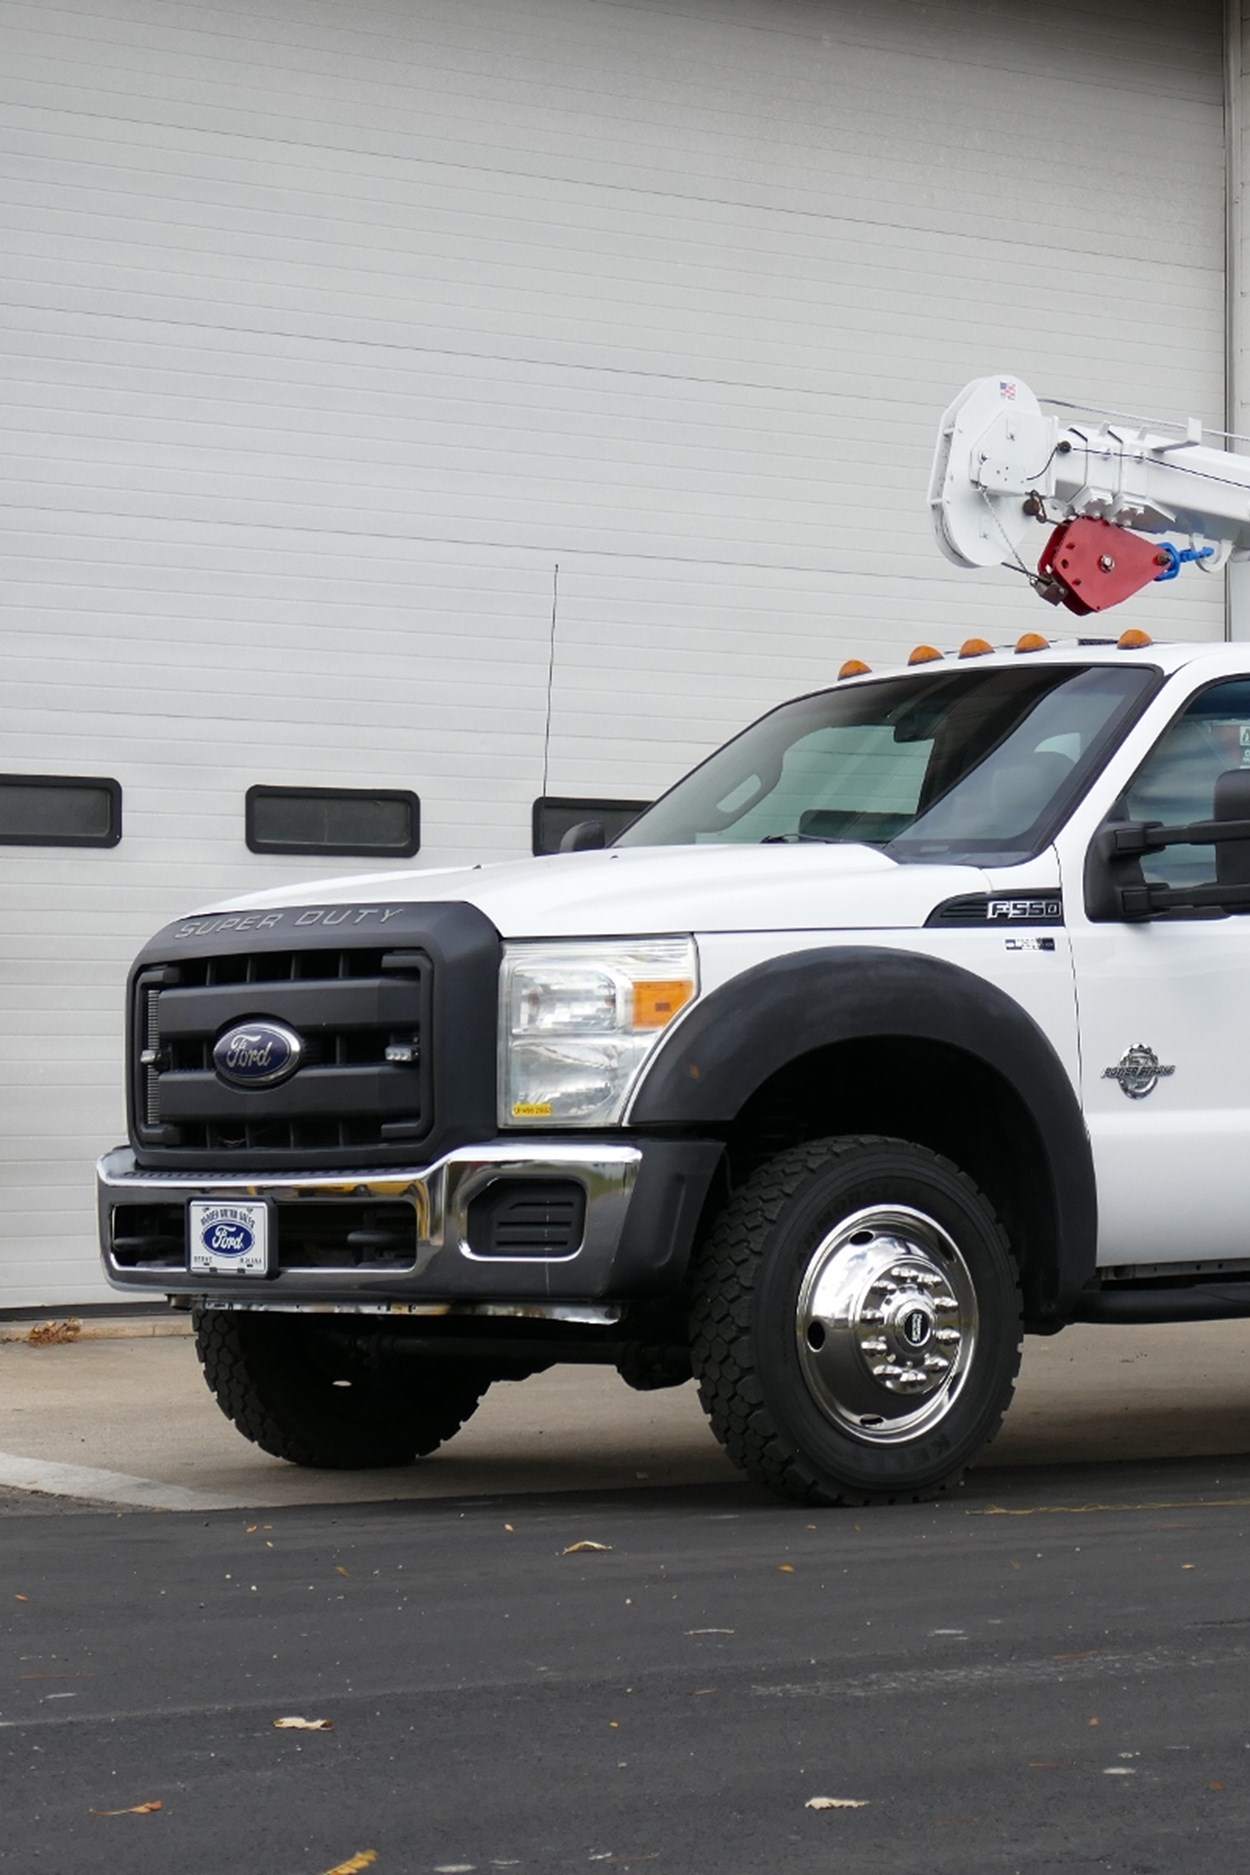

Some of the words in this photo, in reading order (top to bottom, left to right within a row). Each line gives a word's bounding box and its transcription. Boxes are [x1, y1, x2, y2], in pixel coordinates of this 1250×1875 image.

[174, 913, 284, 939] SUPER
[294, 908, 404, 926] DUTY
[987, 901, 1062, 919] F-550
[226, 1034, 273, 1068] Ford
[212, 1224, 245, 1250] Ford
